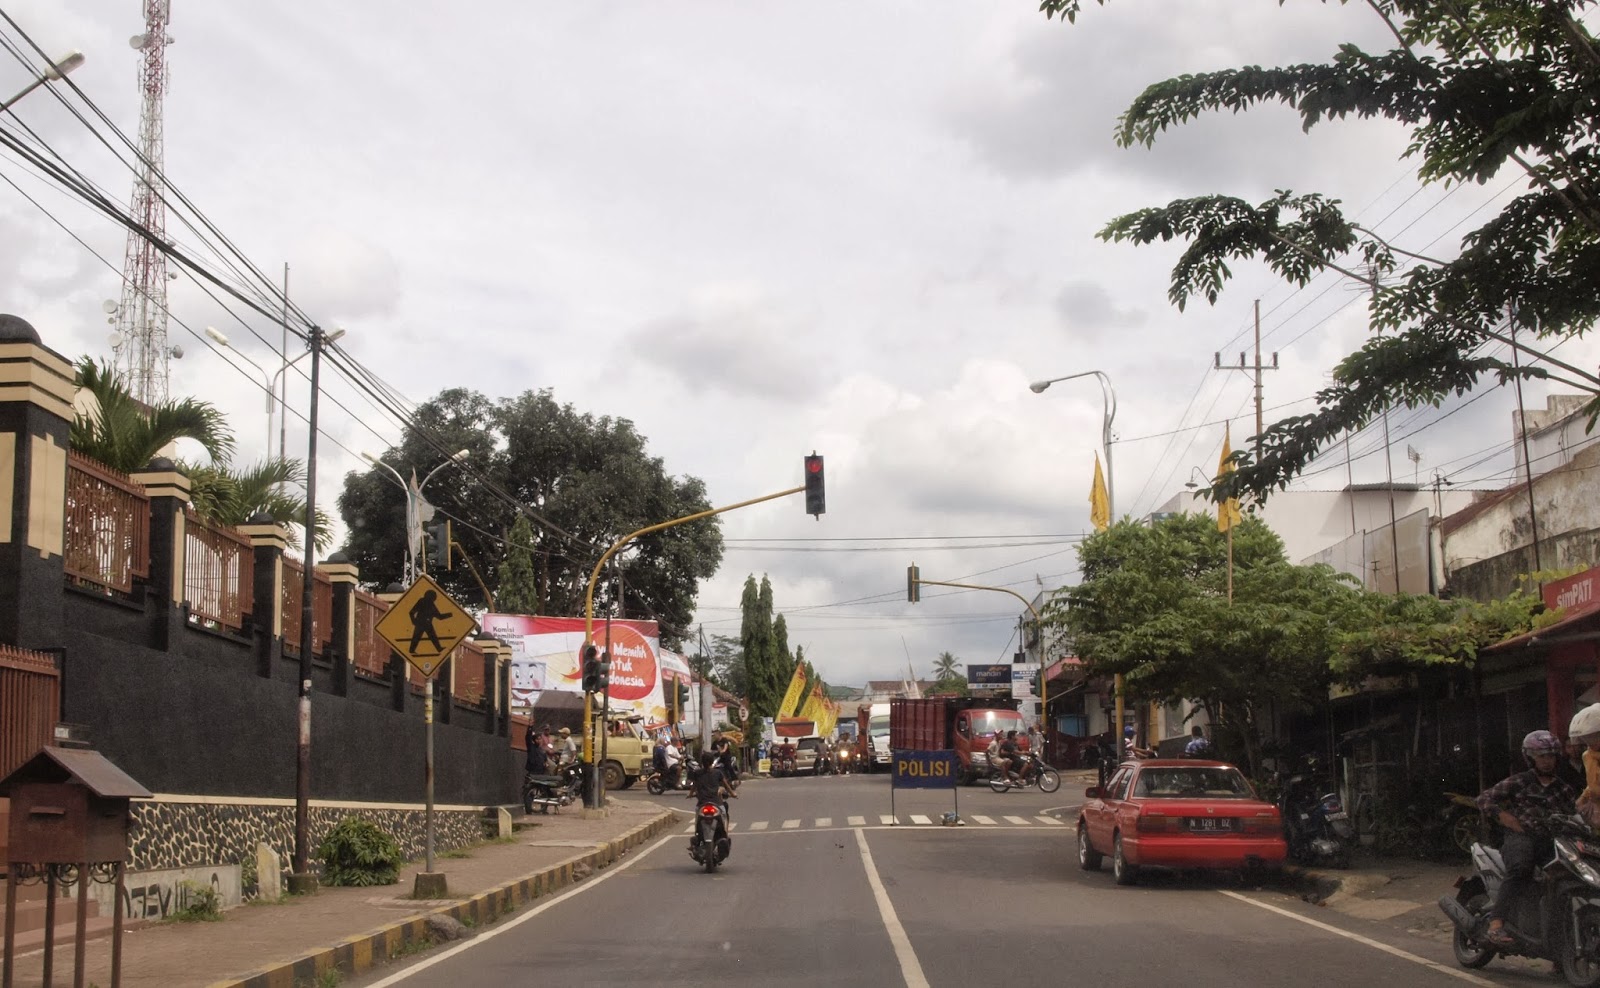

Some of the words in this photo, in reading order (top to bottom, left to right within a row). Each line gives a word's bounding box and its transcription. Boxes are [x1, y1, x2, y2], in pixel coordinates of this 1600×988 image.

[1556, 578, 1593, 608] simPATI
[613, 642, 647, 658] Memilih
[609, 657, 633, 672] ntuk
[898, 760, 951, 777] POLISI
[1190, 818, 1196, 827] N
[1201, 818, 1216, 827] 1281
